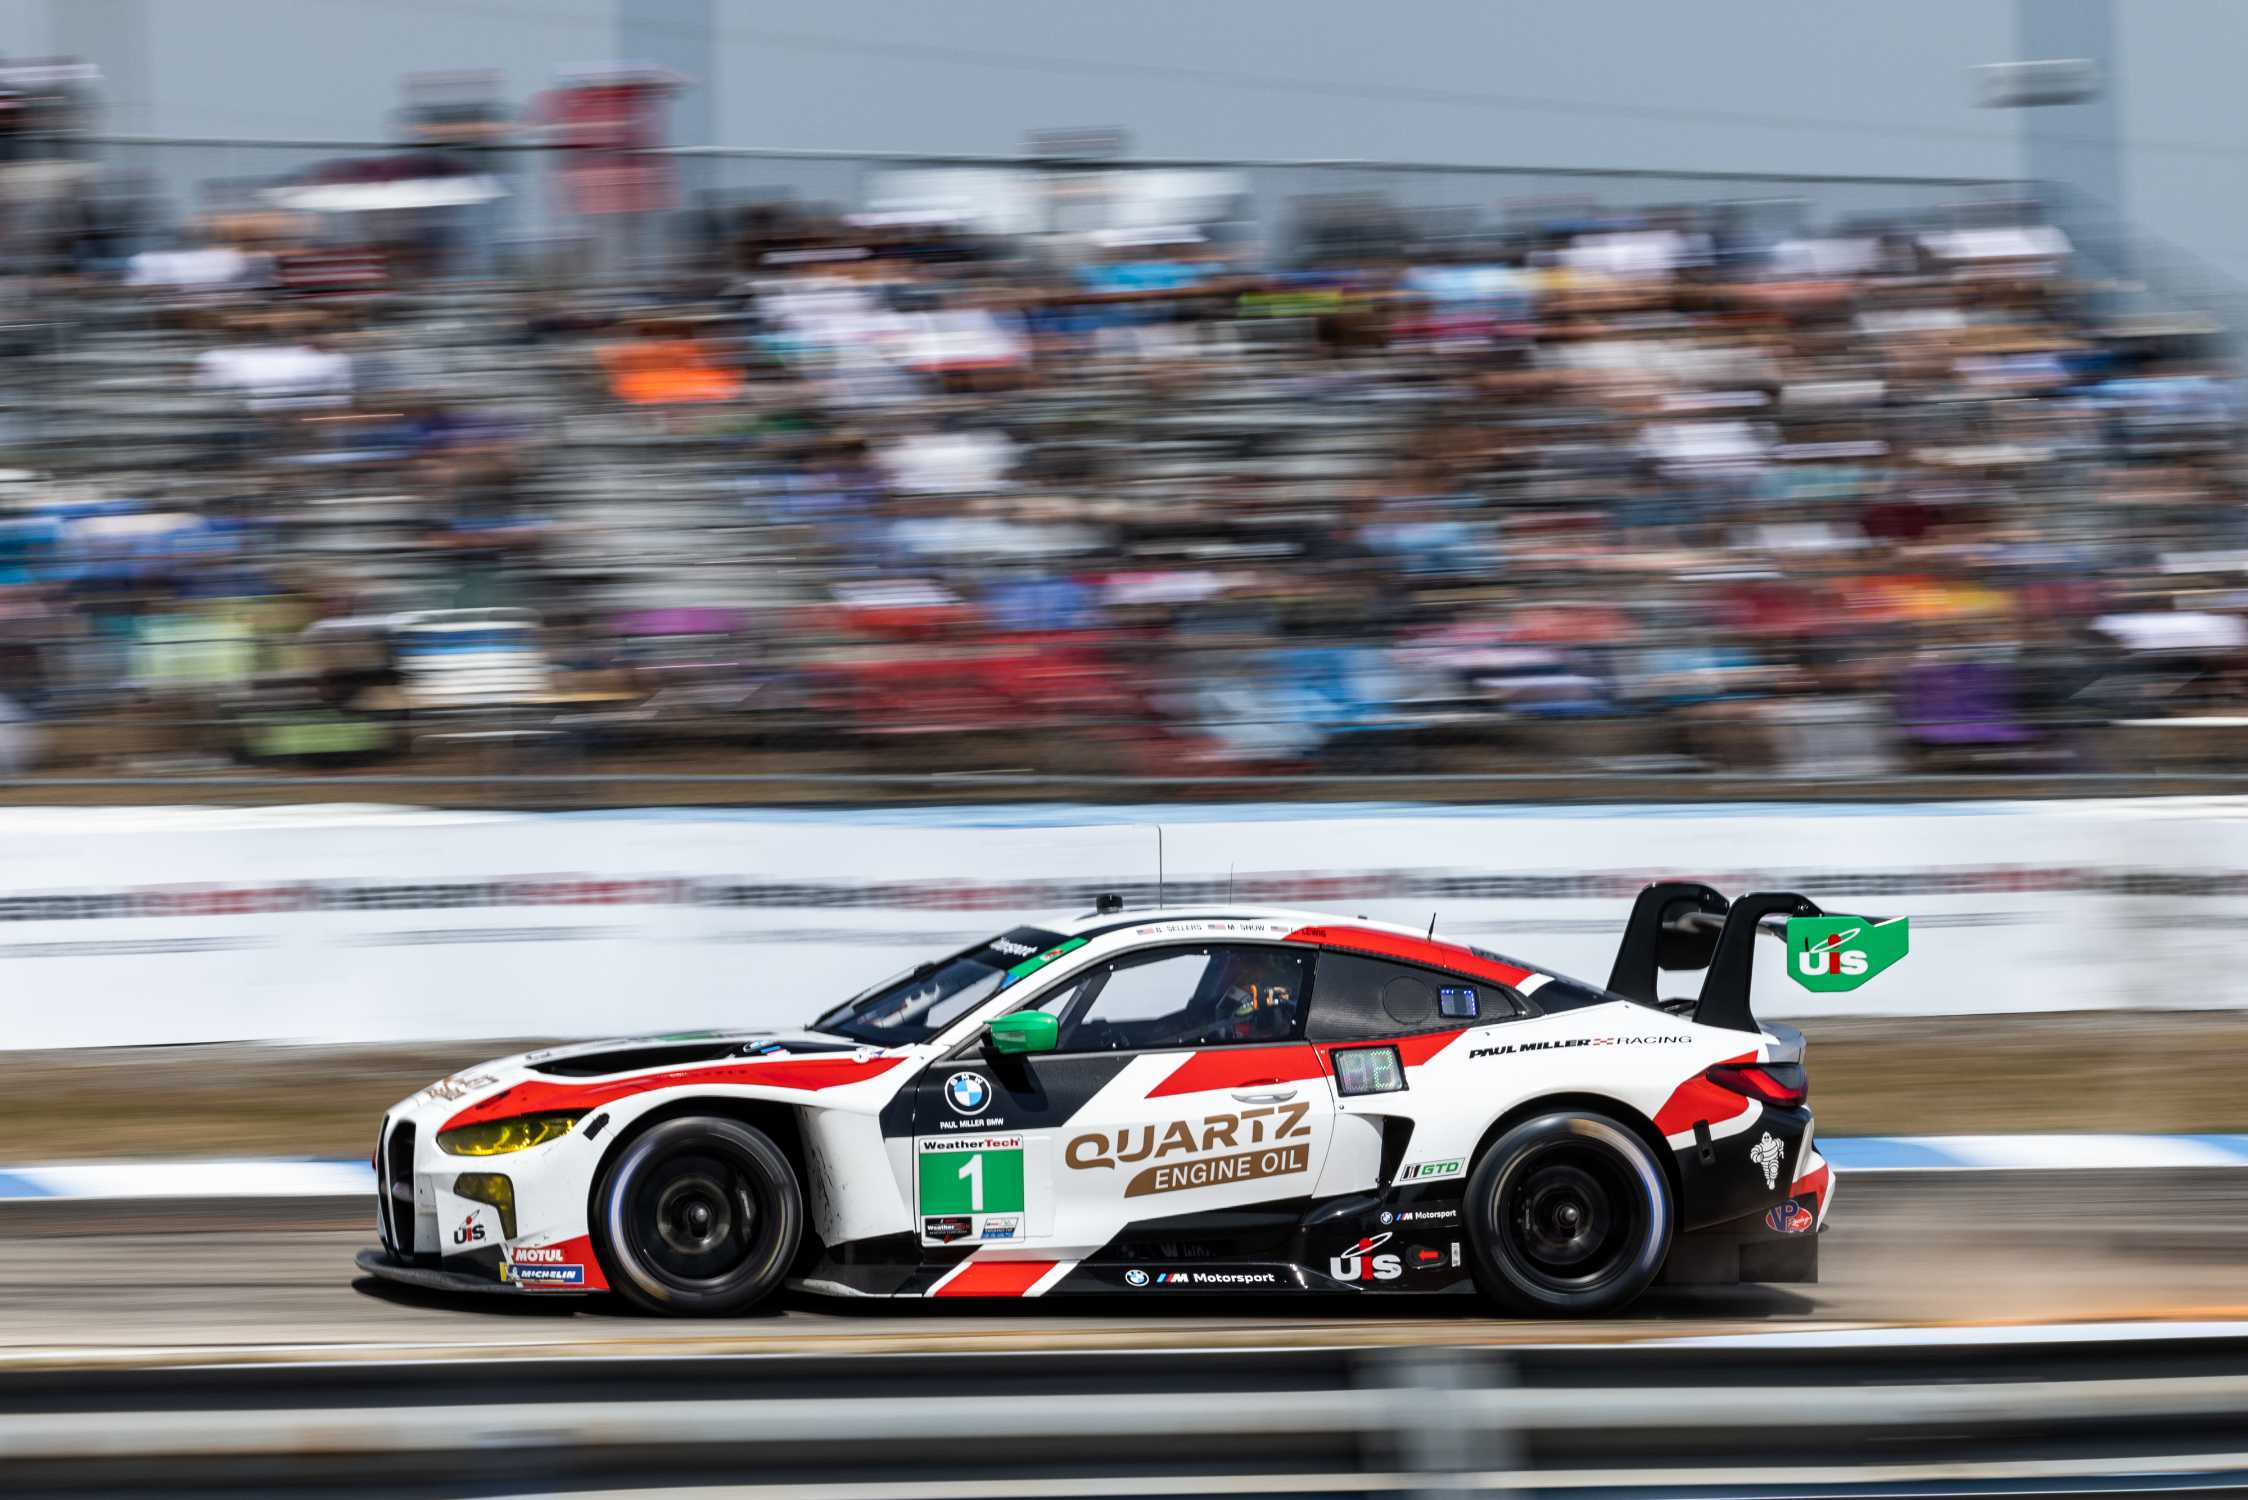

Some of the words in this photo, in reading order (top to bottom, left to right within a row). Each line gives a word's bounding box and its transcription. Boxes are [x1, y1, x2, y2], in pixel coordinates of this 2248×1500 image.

[1240, 923, 1265, 931] SNOW
[1469, 1045, 1516, 1059] PAUL
[1519, 1038, 1591, 1052] MILLER
[1616, 1035, 1692, 1045] RACING
[940, 1121, 958, 1129] PAUL
[960, 1119, 984, 1127] MILLER
[986, 1117, 1004, 1126] BMW
[1065, 1102, 1311, 1170] QUARTZ
[924, 1138, 1020, 1150] WeatherTech
[1155, 1156, 1251, 1190] ENGINE
[1261, 1149, 1303, 1174] OIL
[1422, 1162, 1460, 1175] GTD
[958, 1154, 984, 1210] 1
[1415, 1210, 1457, 1220] Motorsport
[516, 1249, 564, 1262] MOTUL
[521, 1269, 577, 1279] MICHELIN
[1193, 1273, 1275, 1284] Motorsport
